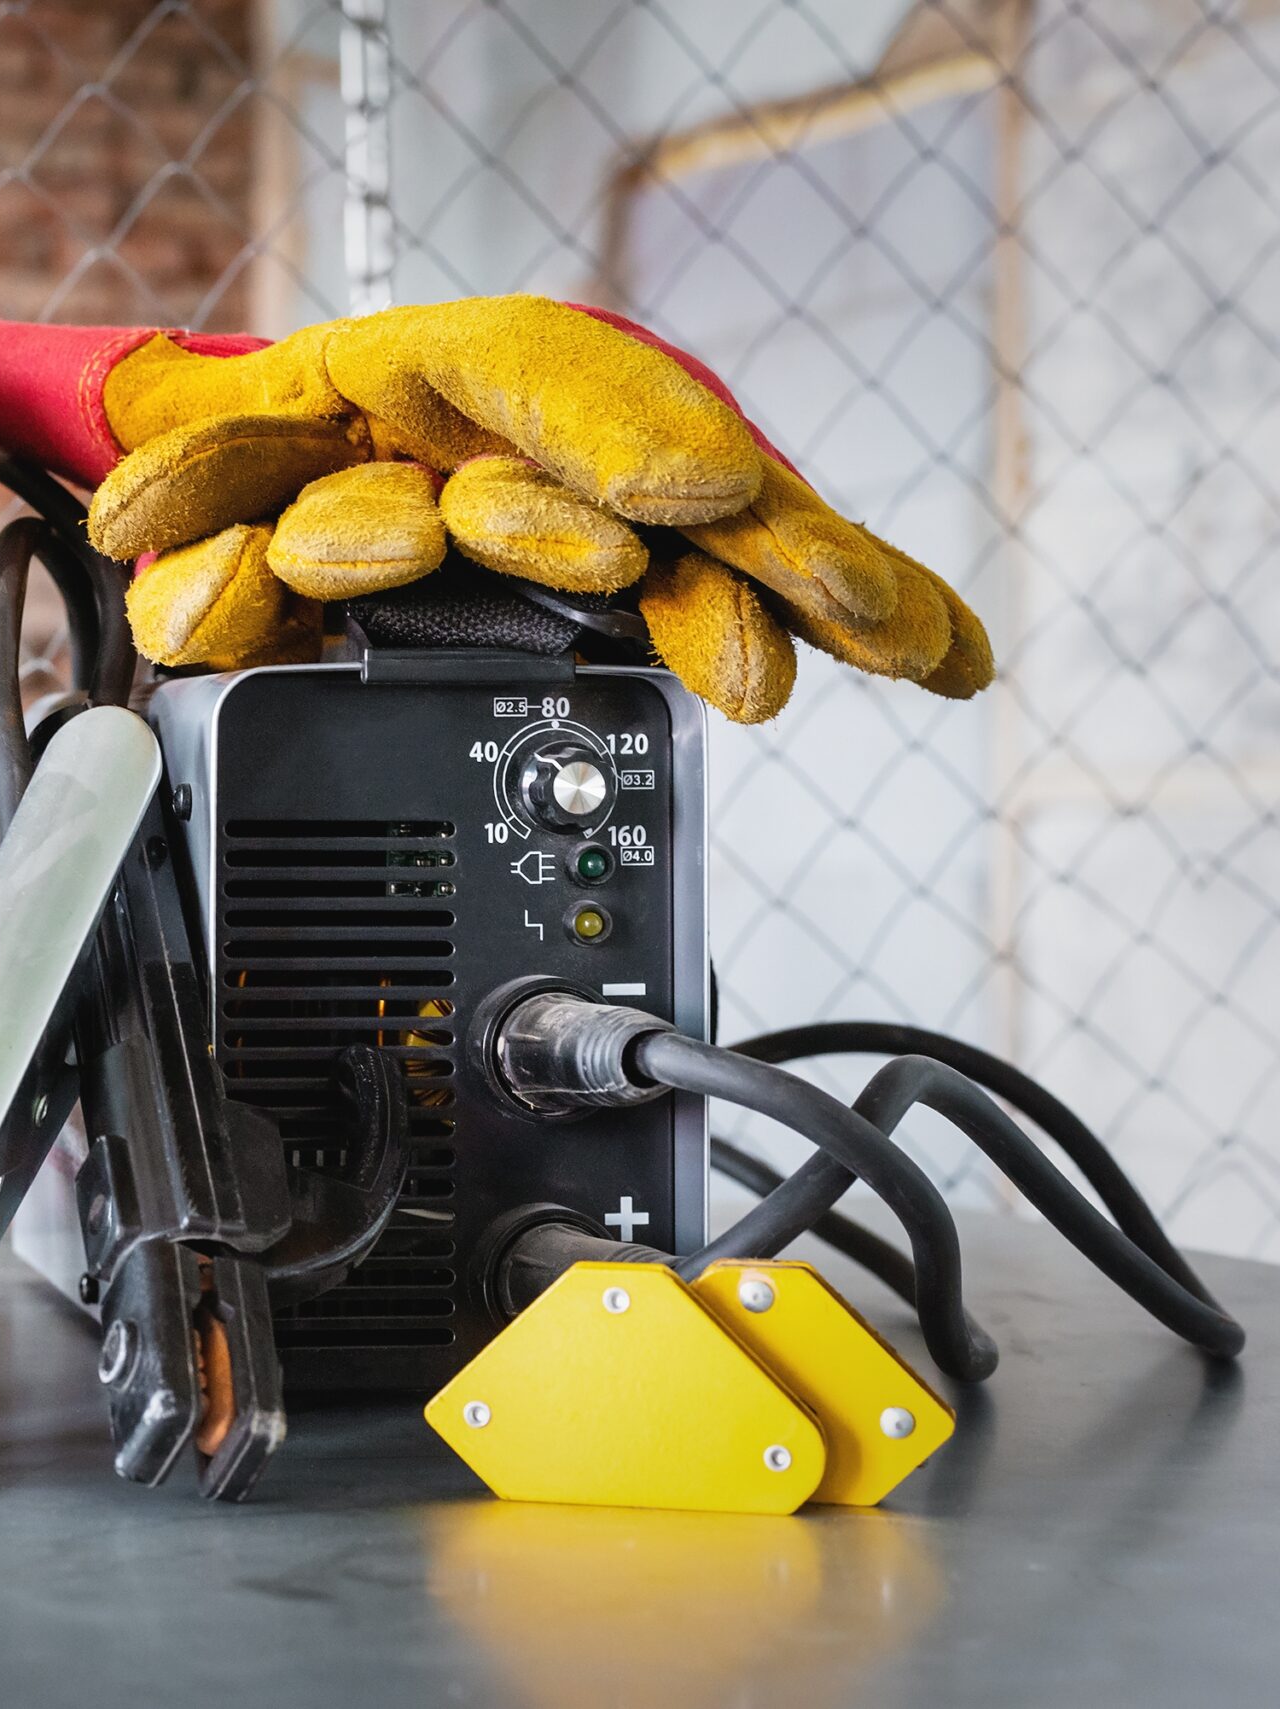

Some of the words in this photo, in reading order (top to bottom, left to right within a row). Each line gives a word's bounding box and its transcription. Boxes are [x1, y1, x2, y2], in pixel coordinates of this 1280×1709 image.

[541, 697, 570, 718] 80
[469, 741, 499, 762] 40
[606, 733, 649, 755] 120
[484, 822, 509, 844] 10
[607, 825, 647, 846] 160
